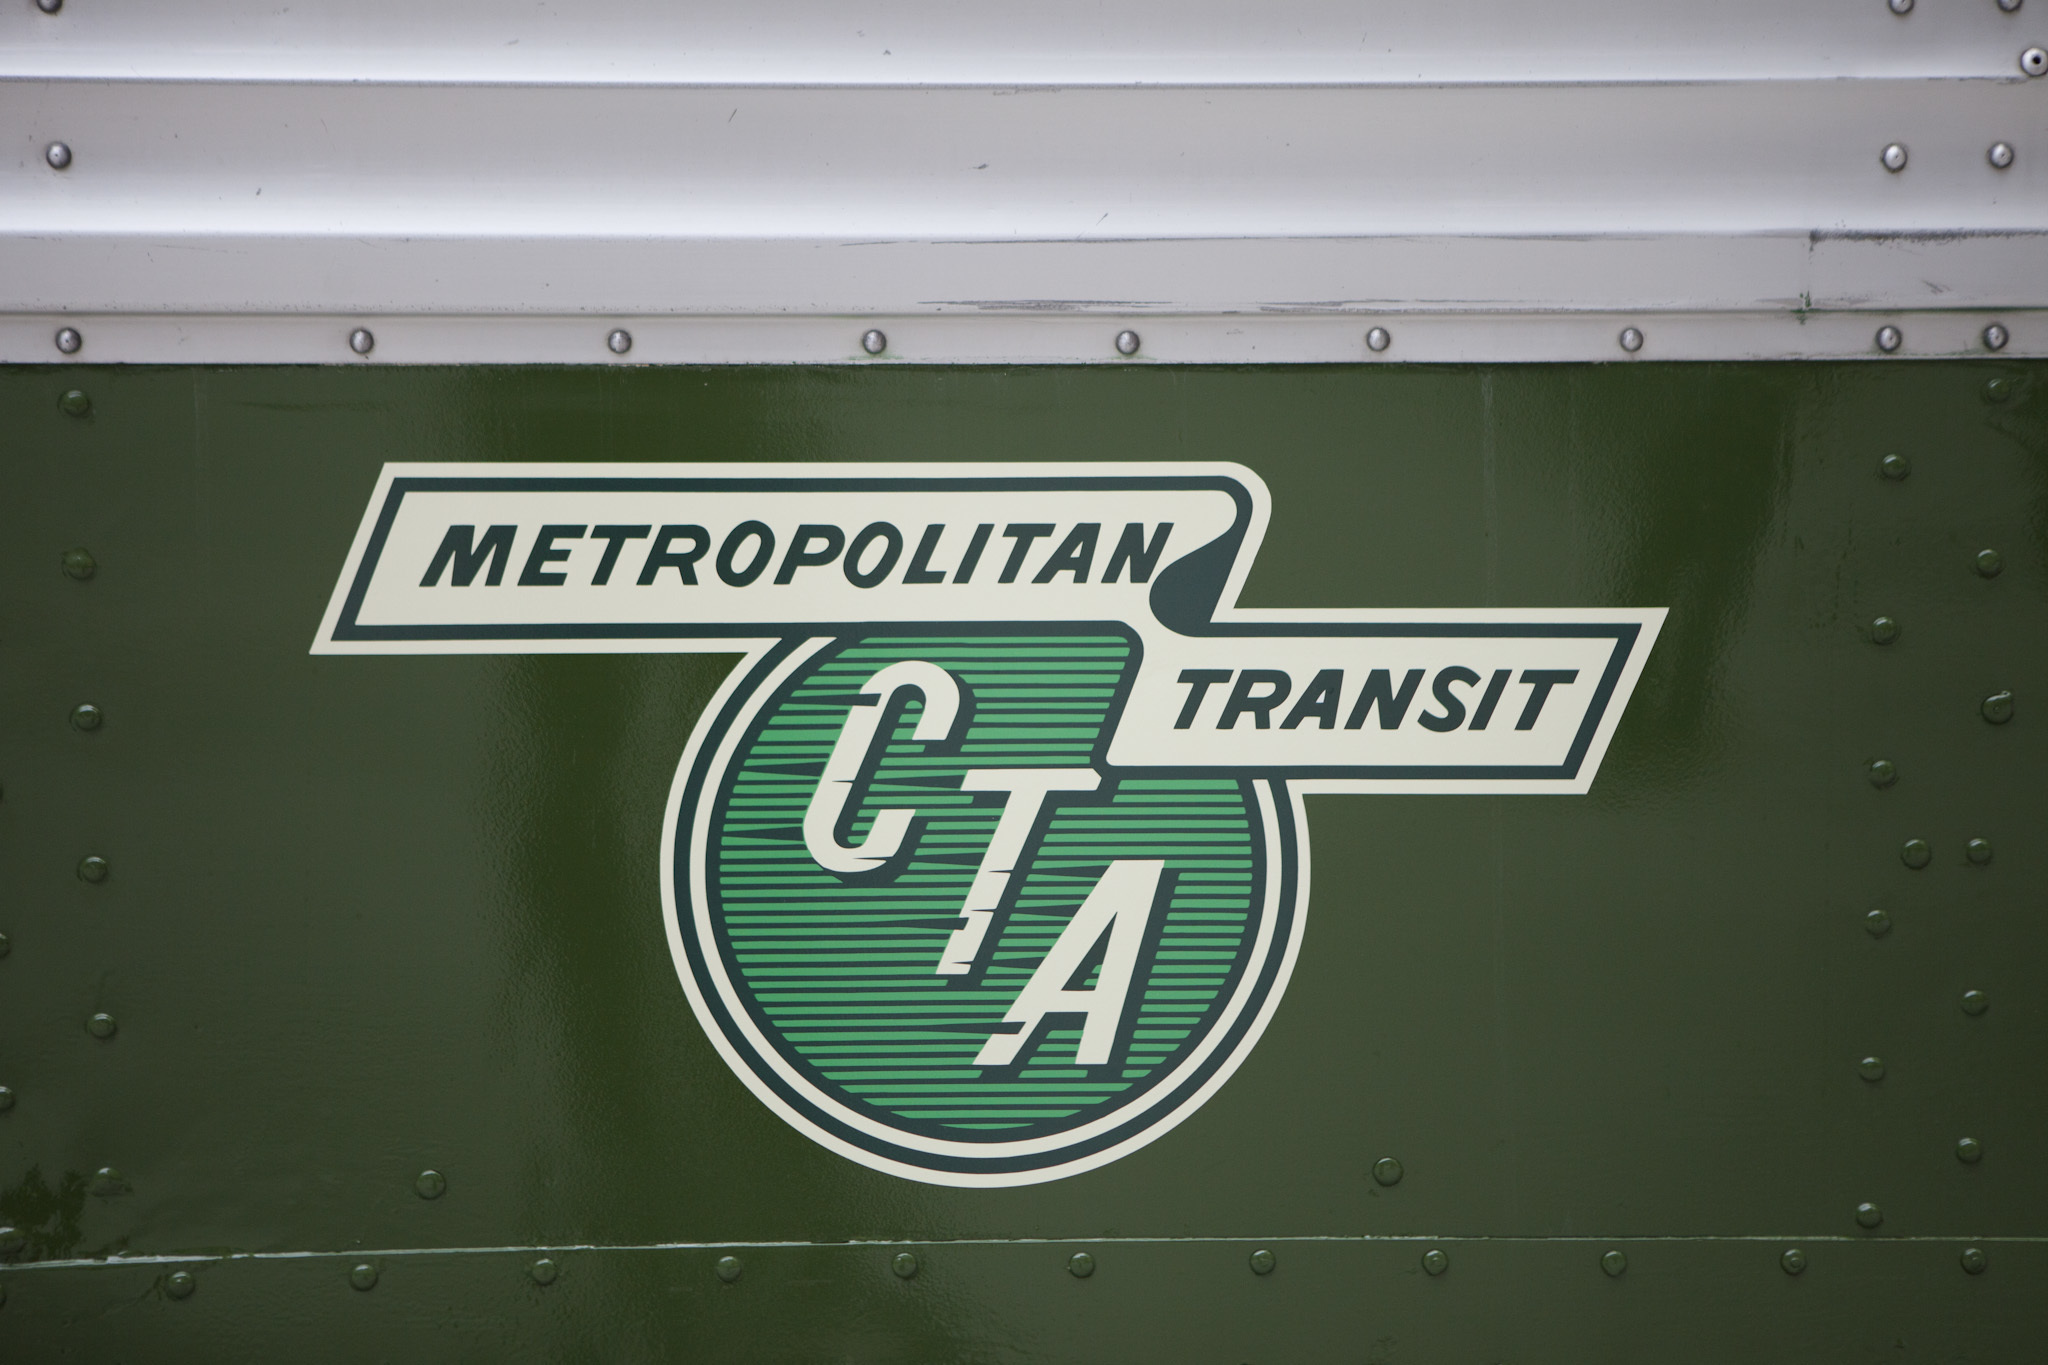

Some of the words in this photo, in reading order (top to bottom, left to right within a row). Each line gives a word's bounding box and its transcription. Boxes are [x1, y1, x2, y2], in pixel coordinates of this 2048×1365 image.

[419, 520, 1174, 588] METROPOLITAN
[1174, 666, 1579, 733] TRANSIT
[803, 660, 1166, 1066] CTA
